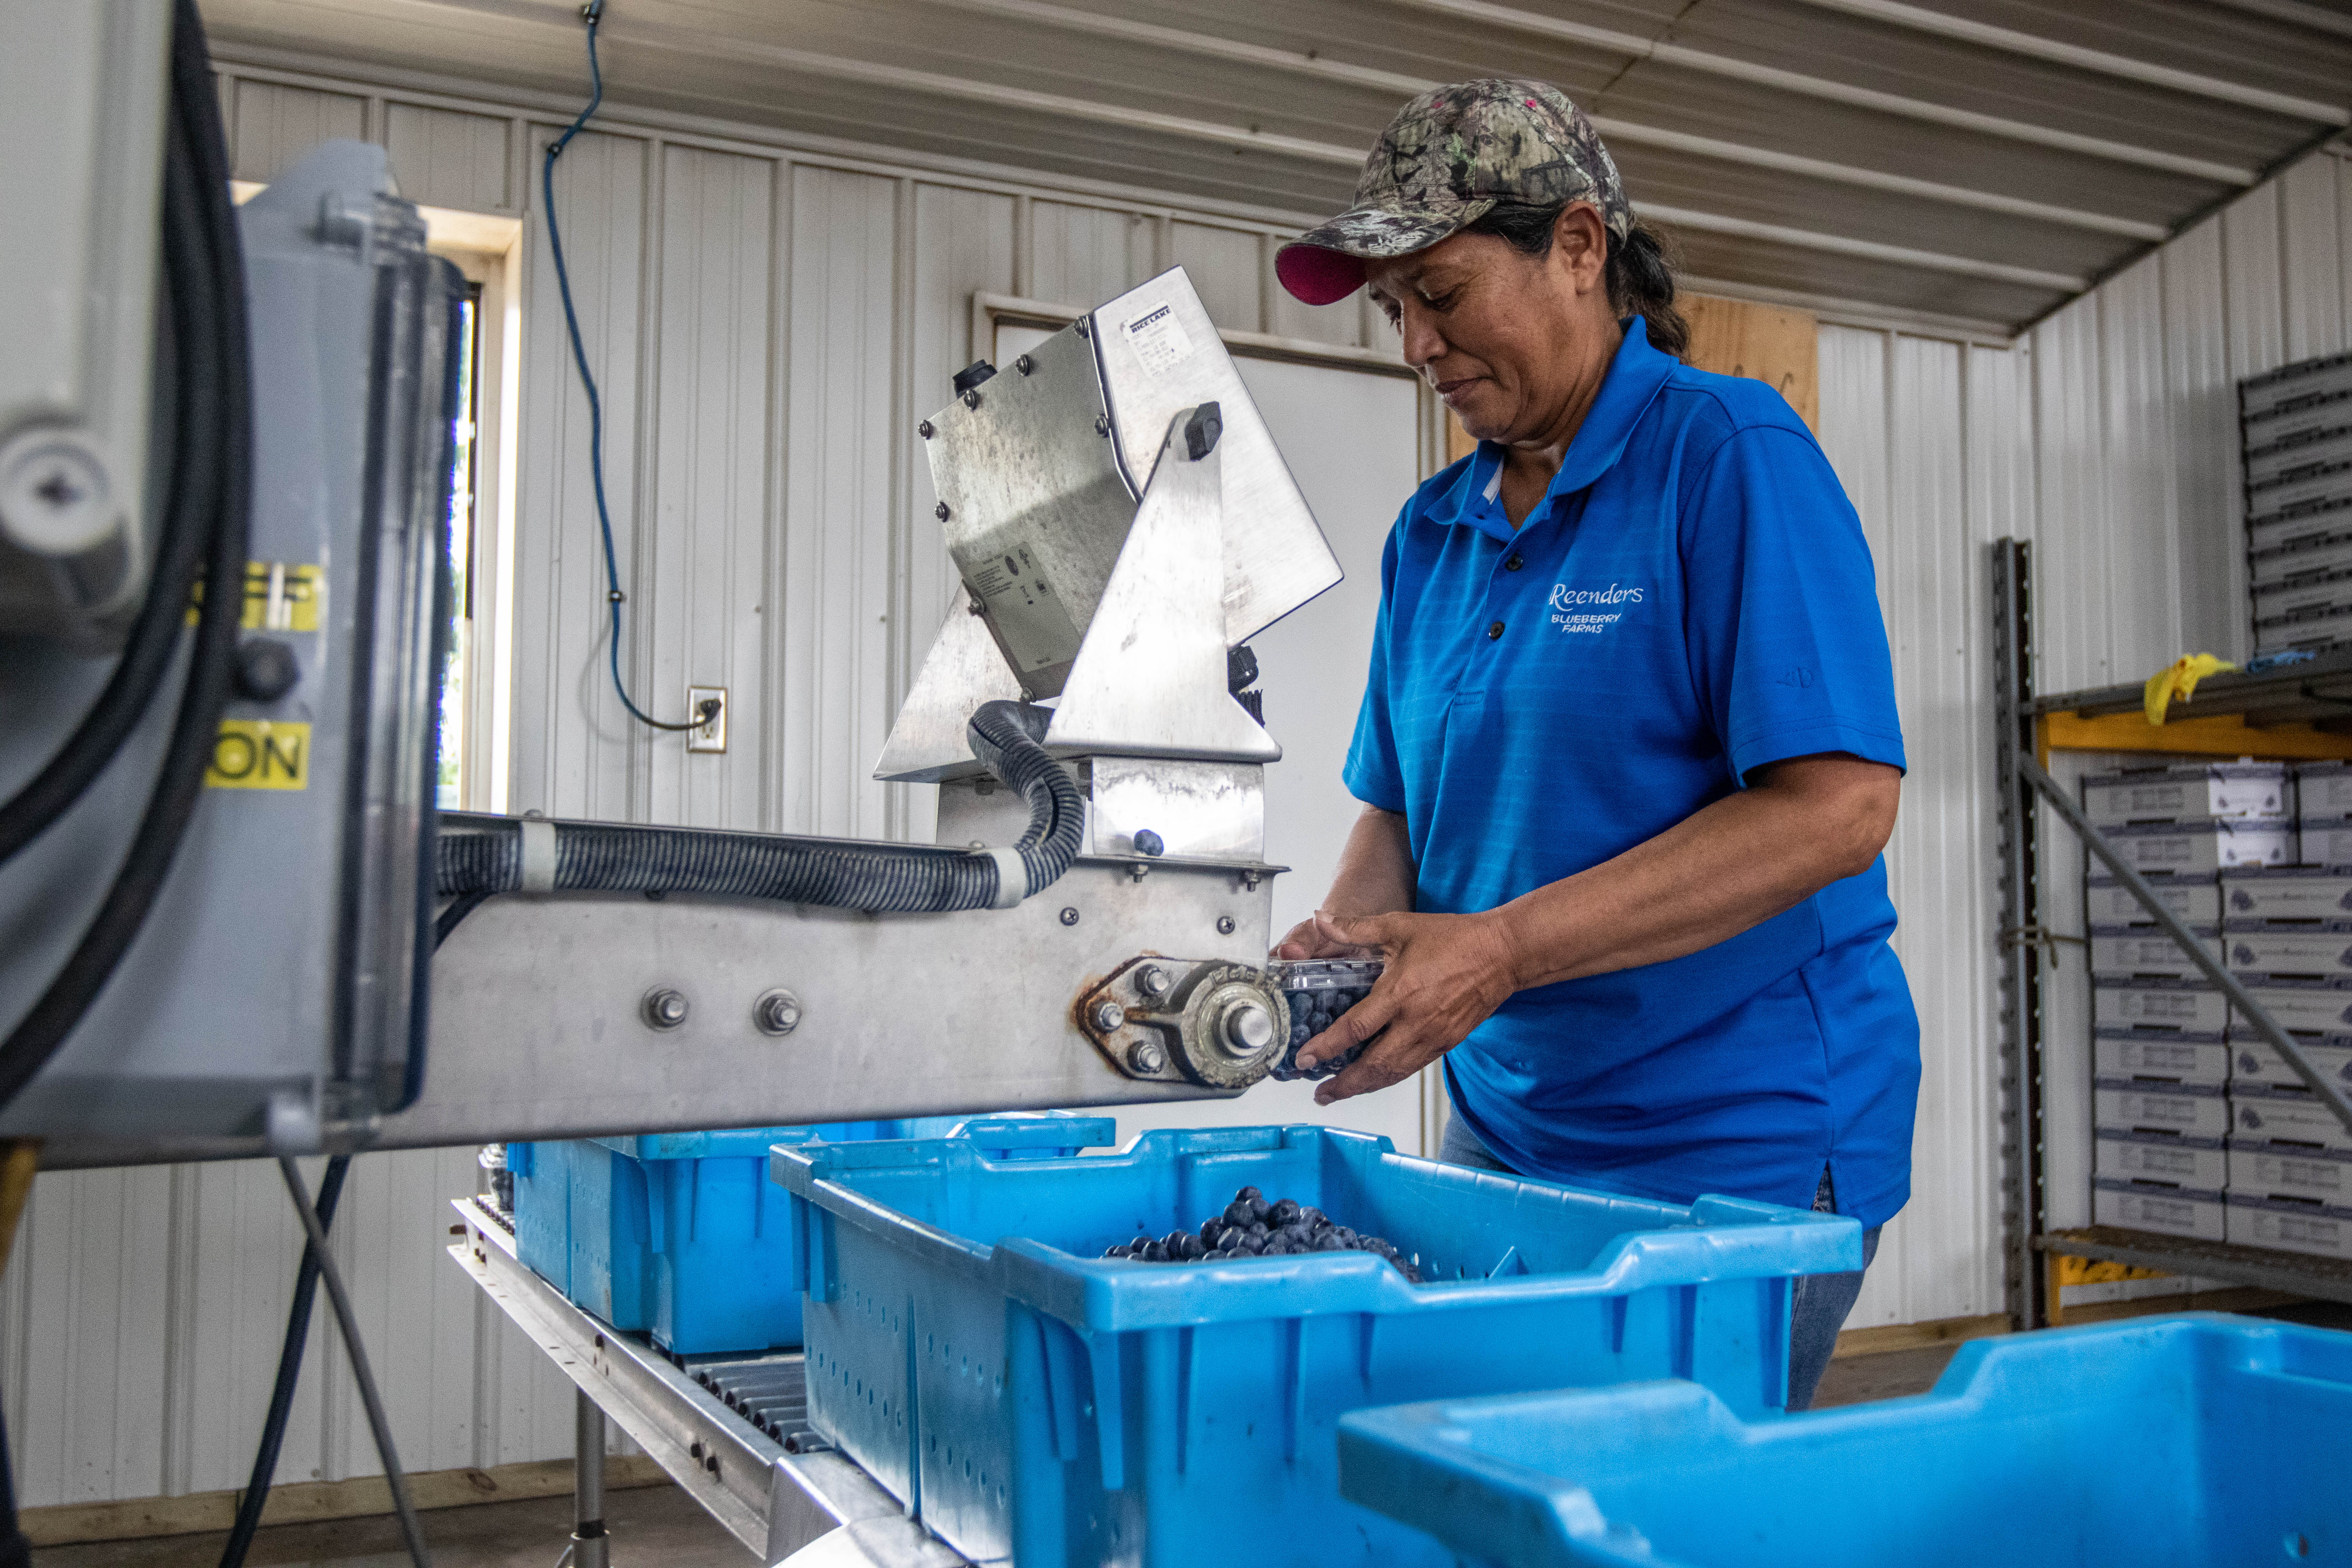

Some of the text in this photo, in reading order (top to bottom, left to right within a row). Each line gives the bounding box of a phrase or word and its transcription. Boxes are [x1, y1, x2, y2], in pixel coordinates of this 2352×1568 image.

[1131, 309, 1171, 333] RICE LAKE
[1549, 583, 1644, 611] Reenders
[1551, 613, 1621, 623] BLUEBERRY
[1562, 624, 1603, 633] FARMS
[213, 731, 300, 779] ON
